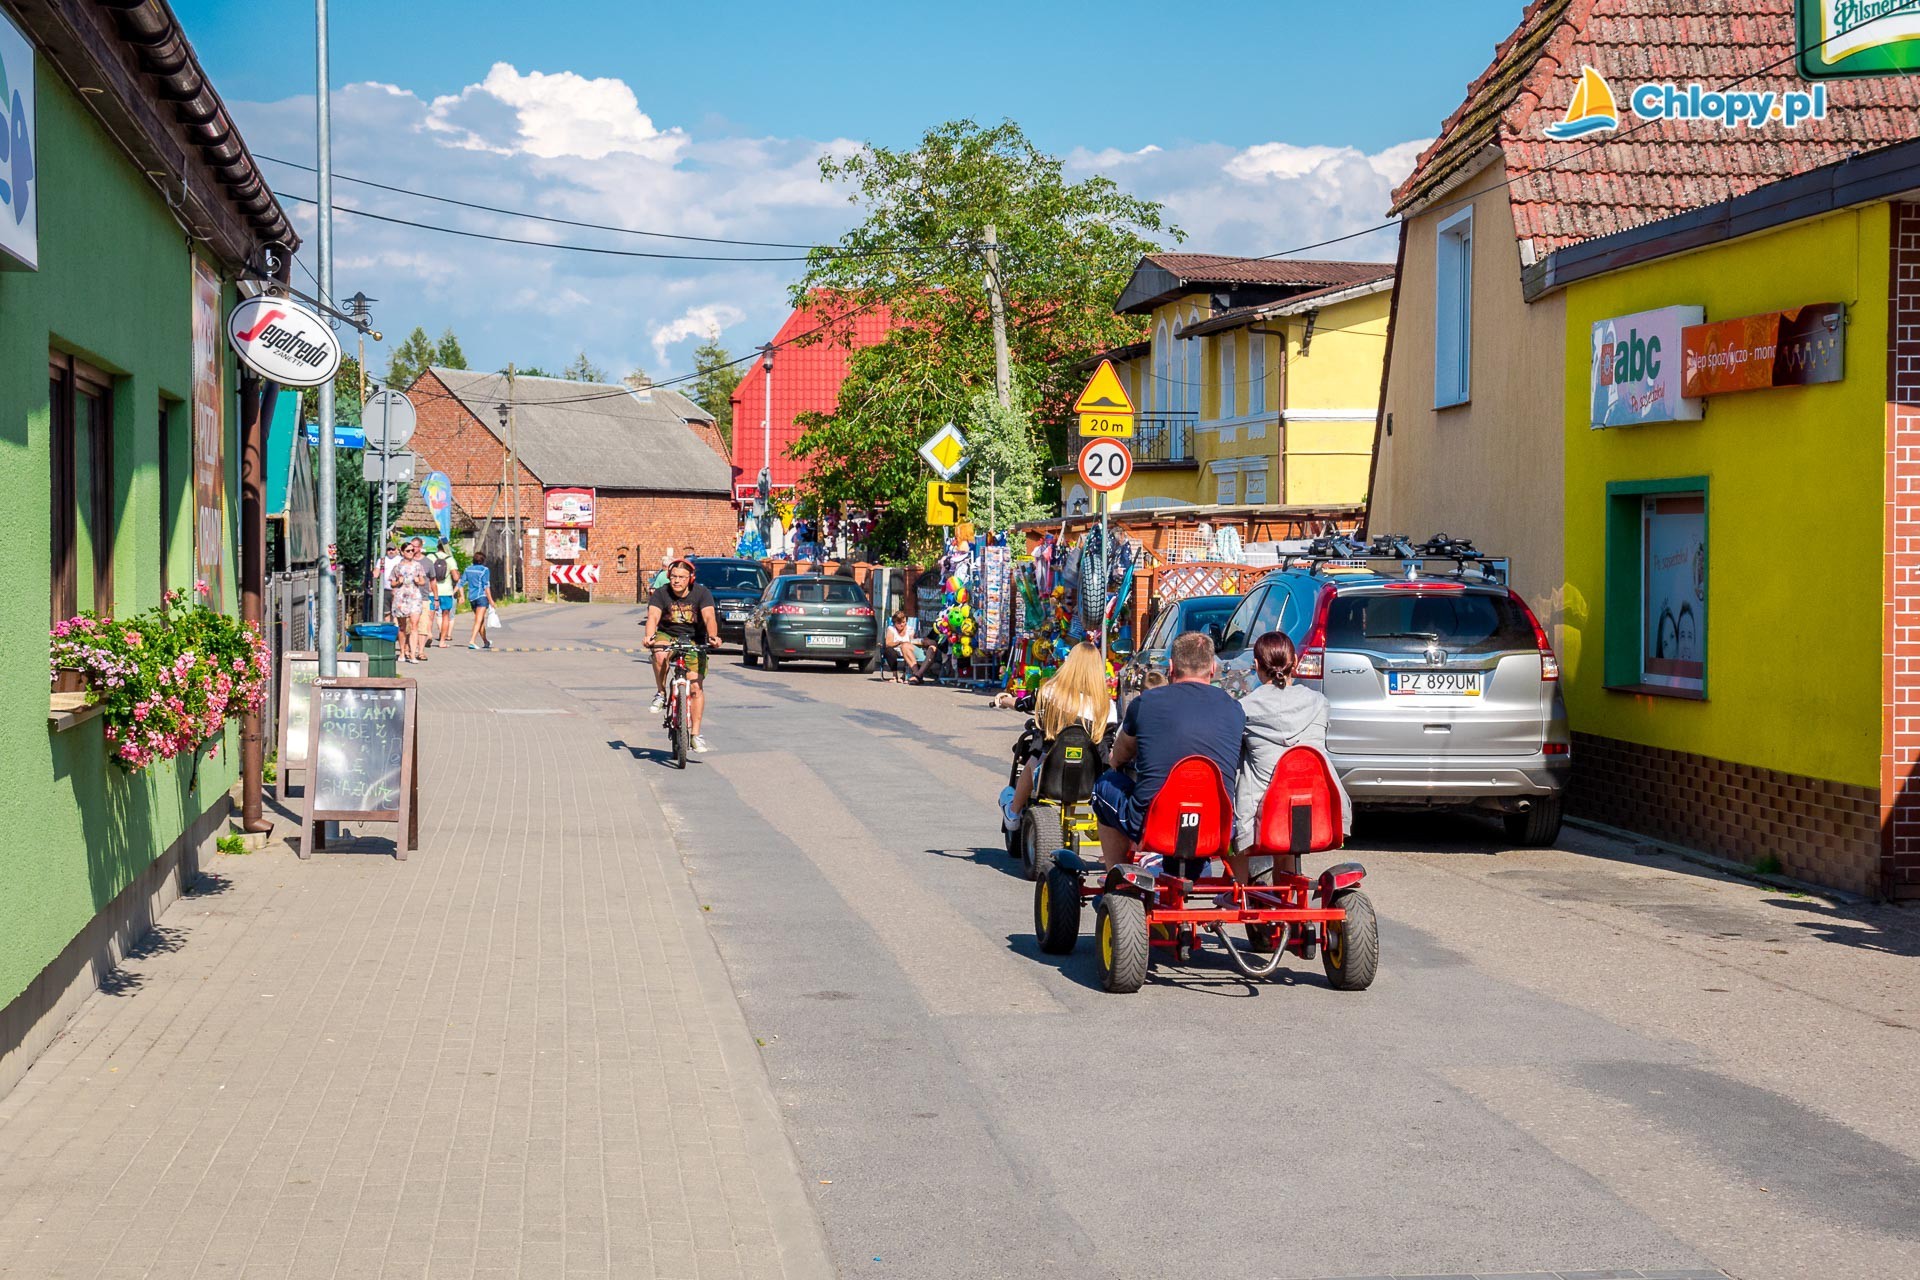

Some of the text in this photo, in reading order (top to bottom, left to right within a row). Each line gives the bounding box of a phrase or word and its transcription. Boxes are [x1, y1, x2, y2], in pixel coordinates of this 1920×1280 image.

[236, 310, 328, 368] Segafredo
[273, 350, 304, 367] ZANETTI
[1614, 328, 1662, 385] abc
[1090, 419, 1123, 432] 20 m
[1088, 453, 1124, 477] 20
[1401, 674, 1476, 690] PZ 899UM
[1181, 812, 1199, 827] 10
